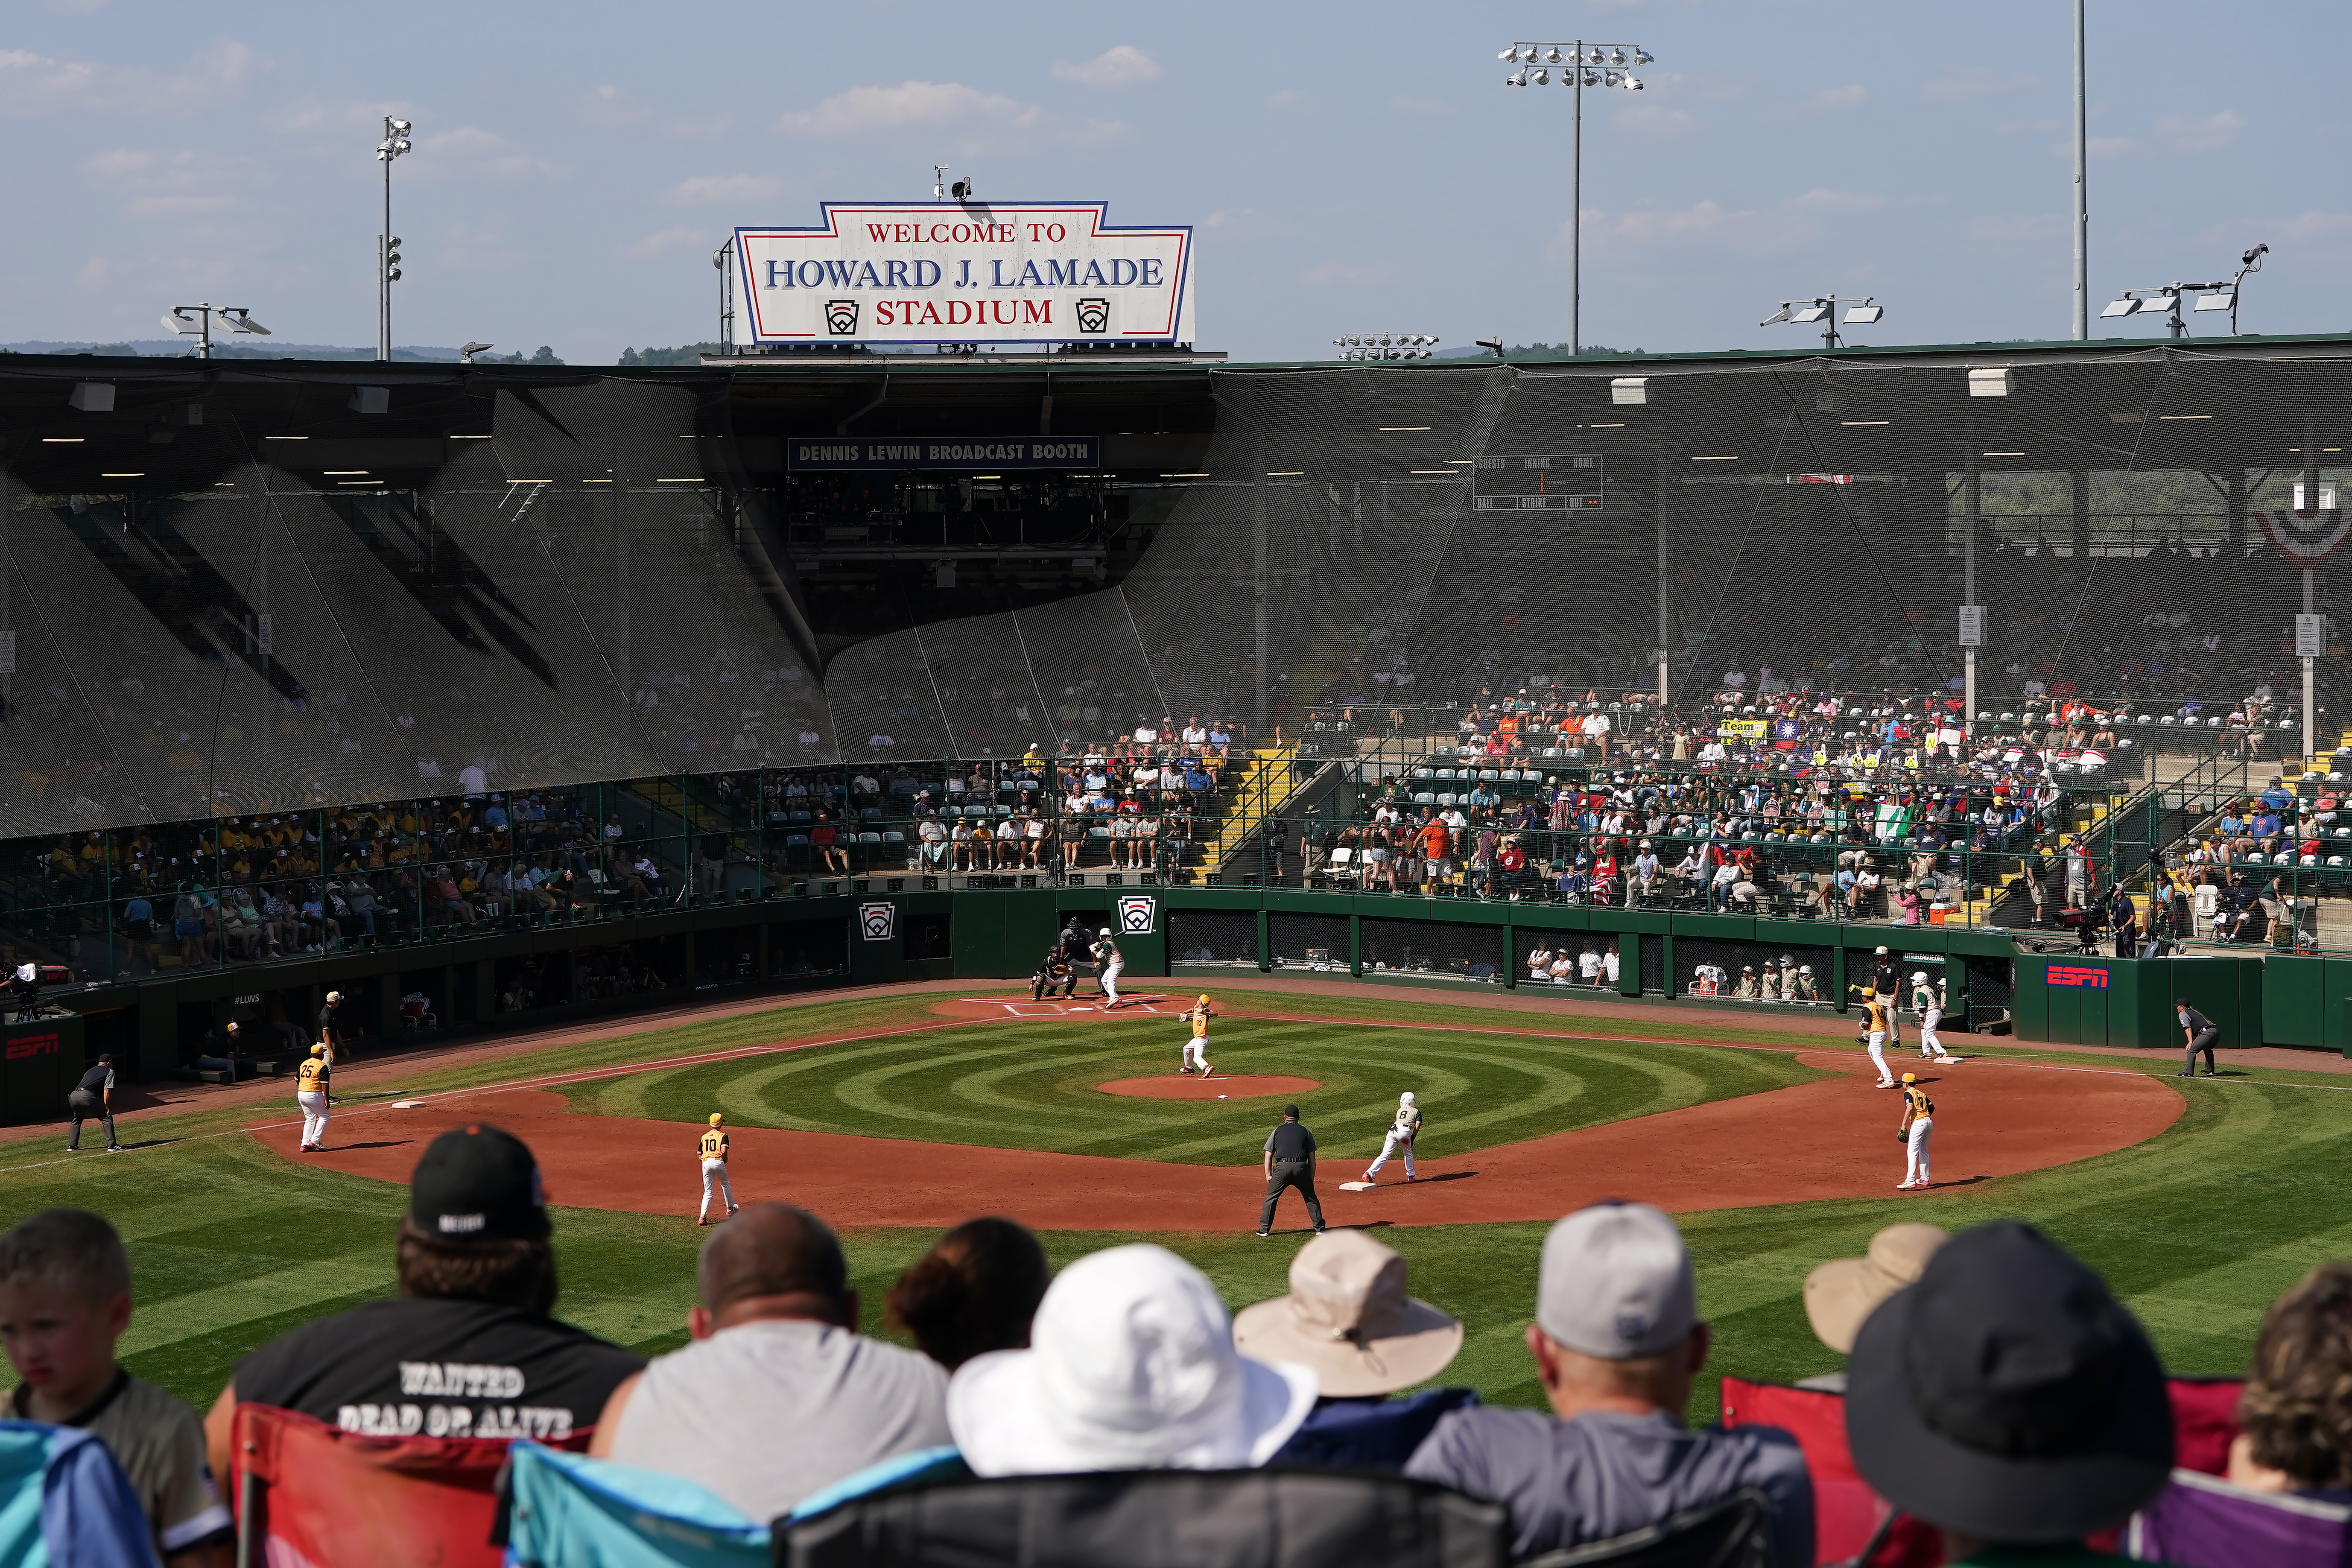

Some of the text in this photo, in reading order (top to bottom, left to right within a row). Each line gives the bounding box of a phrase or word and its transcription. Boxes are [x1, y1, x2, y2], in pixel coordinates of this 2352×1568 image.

[866, 222, 1066, 243] WELCOME TO
[764, 258, 1164, 290] HOWARD J. LAMADE
[876, 300, 1053, 325] STADIUM
[799, 444, 1088, 461] DENNIS LEWIN BROADCAST BOOTH
[1478, 458, 1593, 469] GUESTS INNING HOME
[1477, 497, 1583, 508] BALL STRIKE OUT
[1722, 721, 1754, 730] Team
[2256, 818, 2267, 832] P
[1904, 952, 1945, 962] LITTLELEAGUE.ORG
[2047, 966, 2108, 988] ESPN
[234, 993, 260, 1005] #LLWS
[6, 1033, 58, 1060] ESPN
[300, 1065, 314, 1078] 25
[1917, 1096, 1924, 1109] 7
[1399, 1110, 1408, 1119] 8
[705, 1139, 717, 1152] 10
[399, 1361, 525, 1397] WANTED
[337, 1403, 573, 1438] DEAD OR ALIVE
